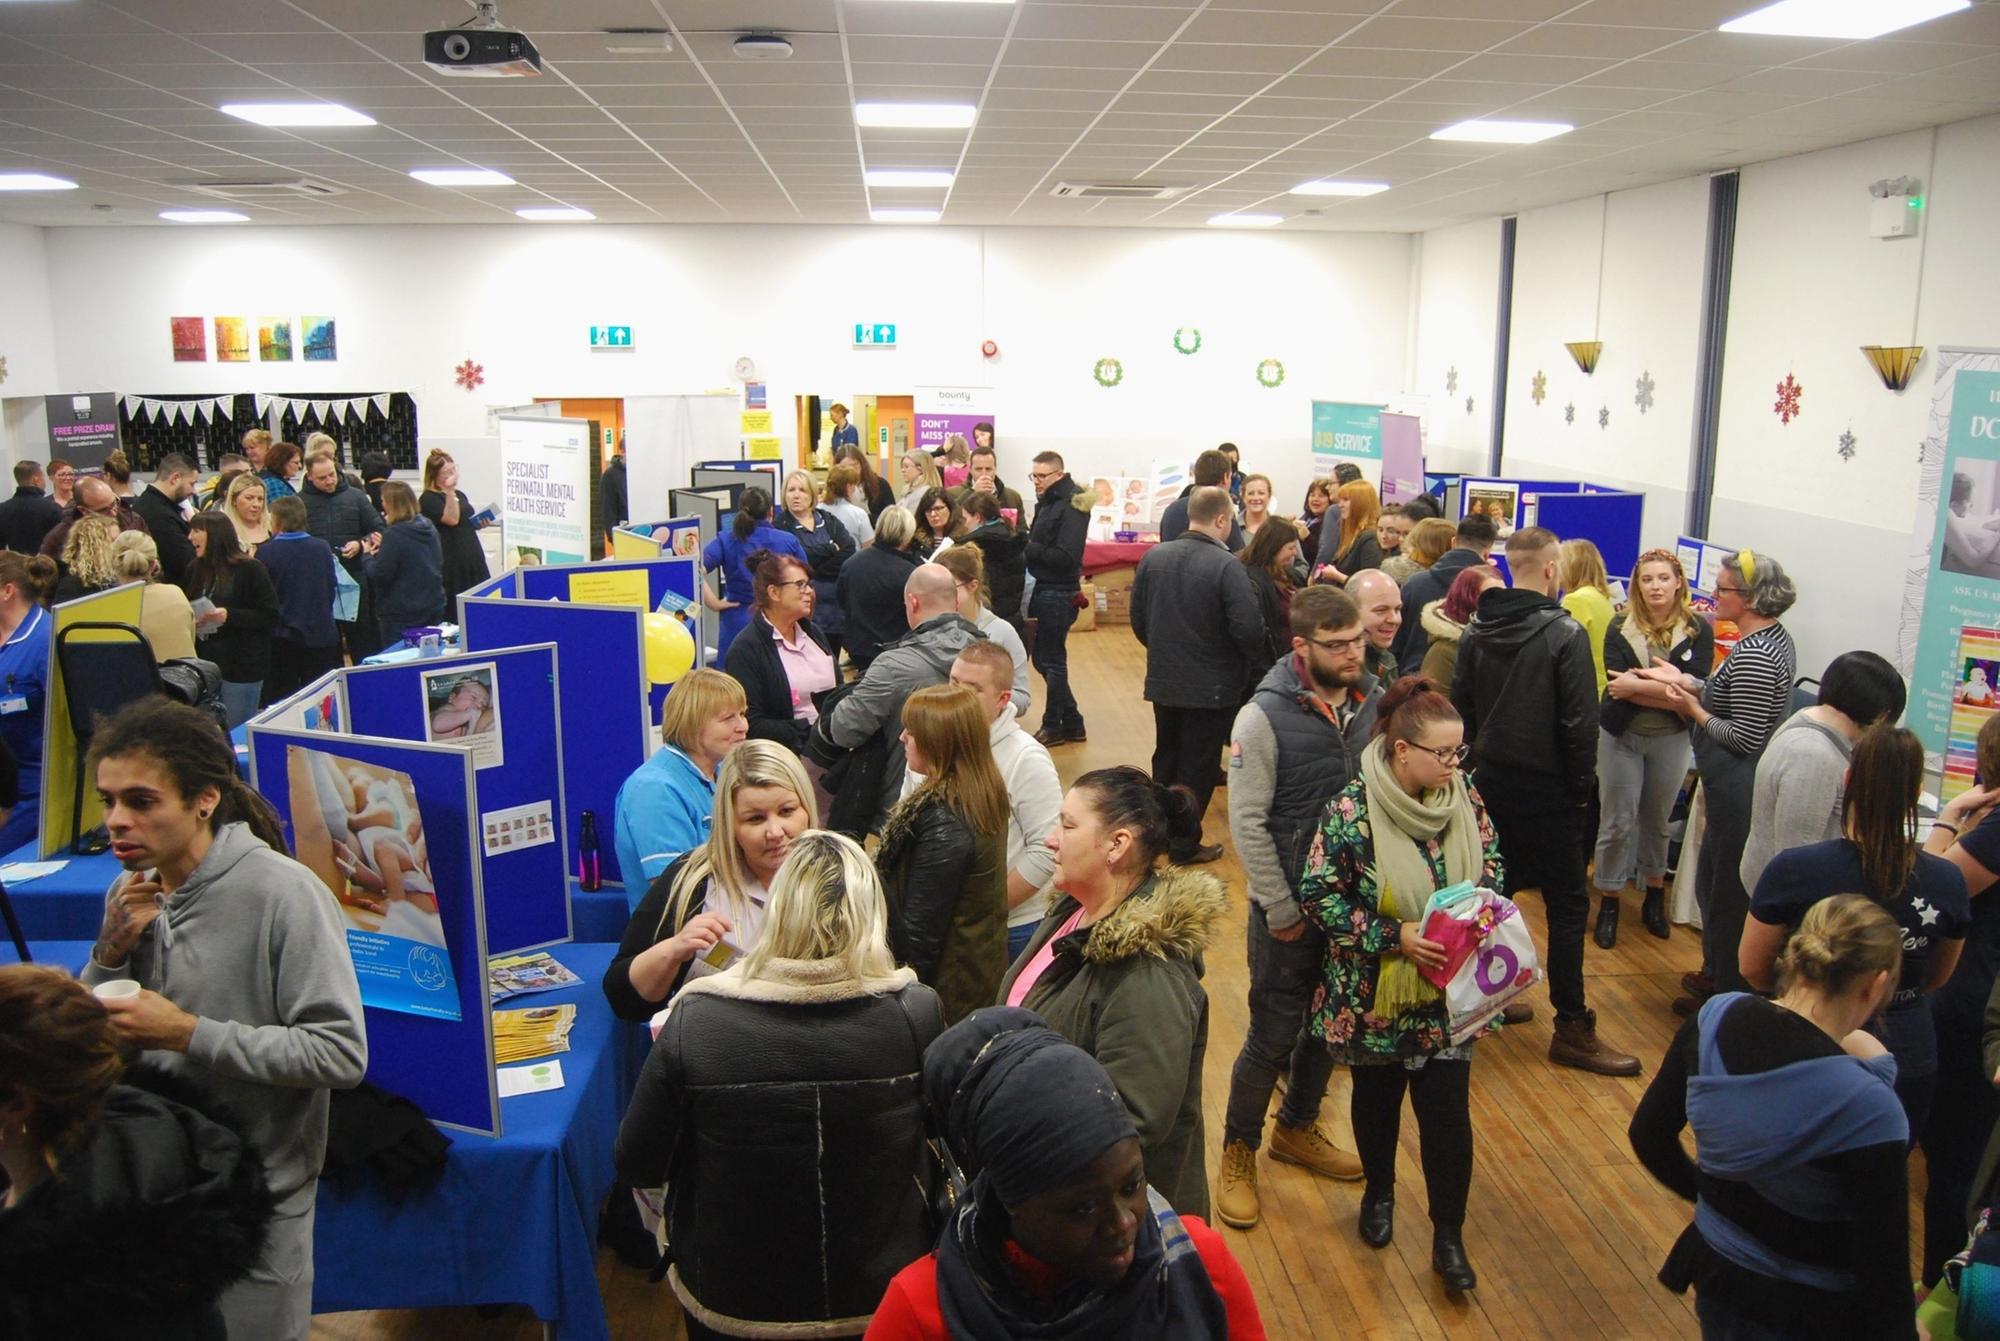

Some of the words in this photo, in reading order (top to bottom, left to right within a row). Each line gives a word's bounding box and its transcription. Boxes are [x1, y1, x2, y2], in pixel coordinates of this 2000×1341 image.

[939, 392, 970, 401] bounty
[54, 427, 72, 435] FREE
[74, 425, 94, 434] PRIZE
[95, 424, 115, 432] DRAW
[921, 420, 950, 428] DON'T
[922, 432, 943, 440] MISS
[1335, 433, 1372, 452] SERVICE
[507, 462, 549, 479] SPECIALIST
[506, 479, 545, 498] PERINATAL
[546, 483, 575, 501] MENTAL
[506, 497, 535, 513] HEALTH
[535, 500, 567, 518] SERVICE
